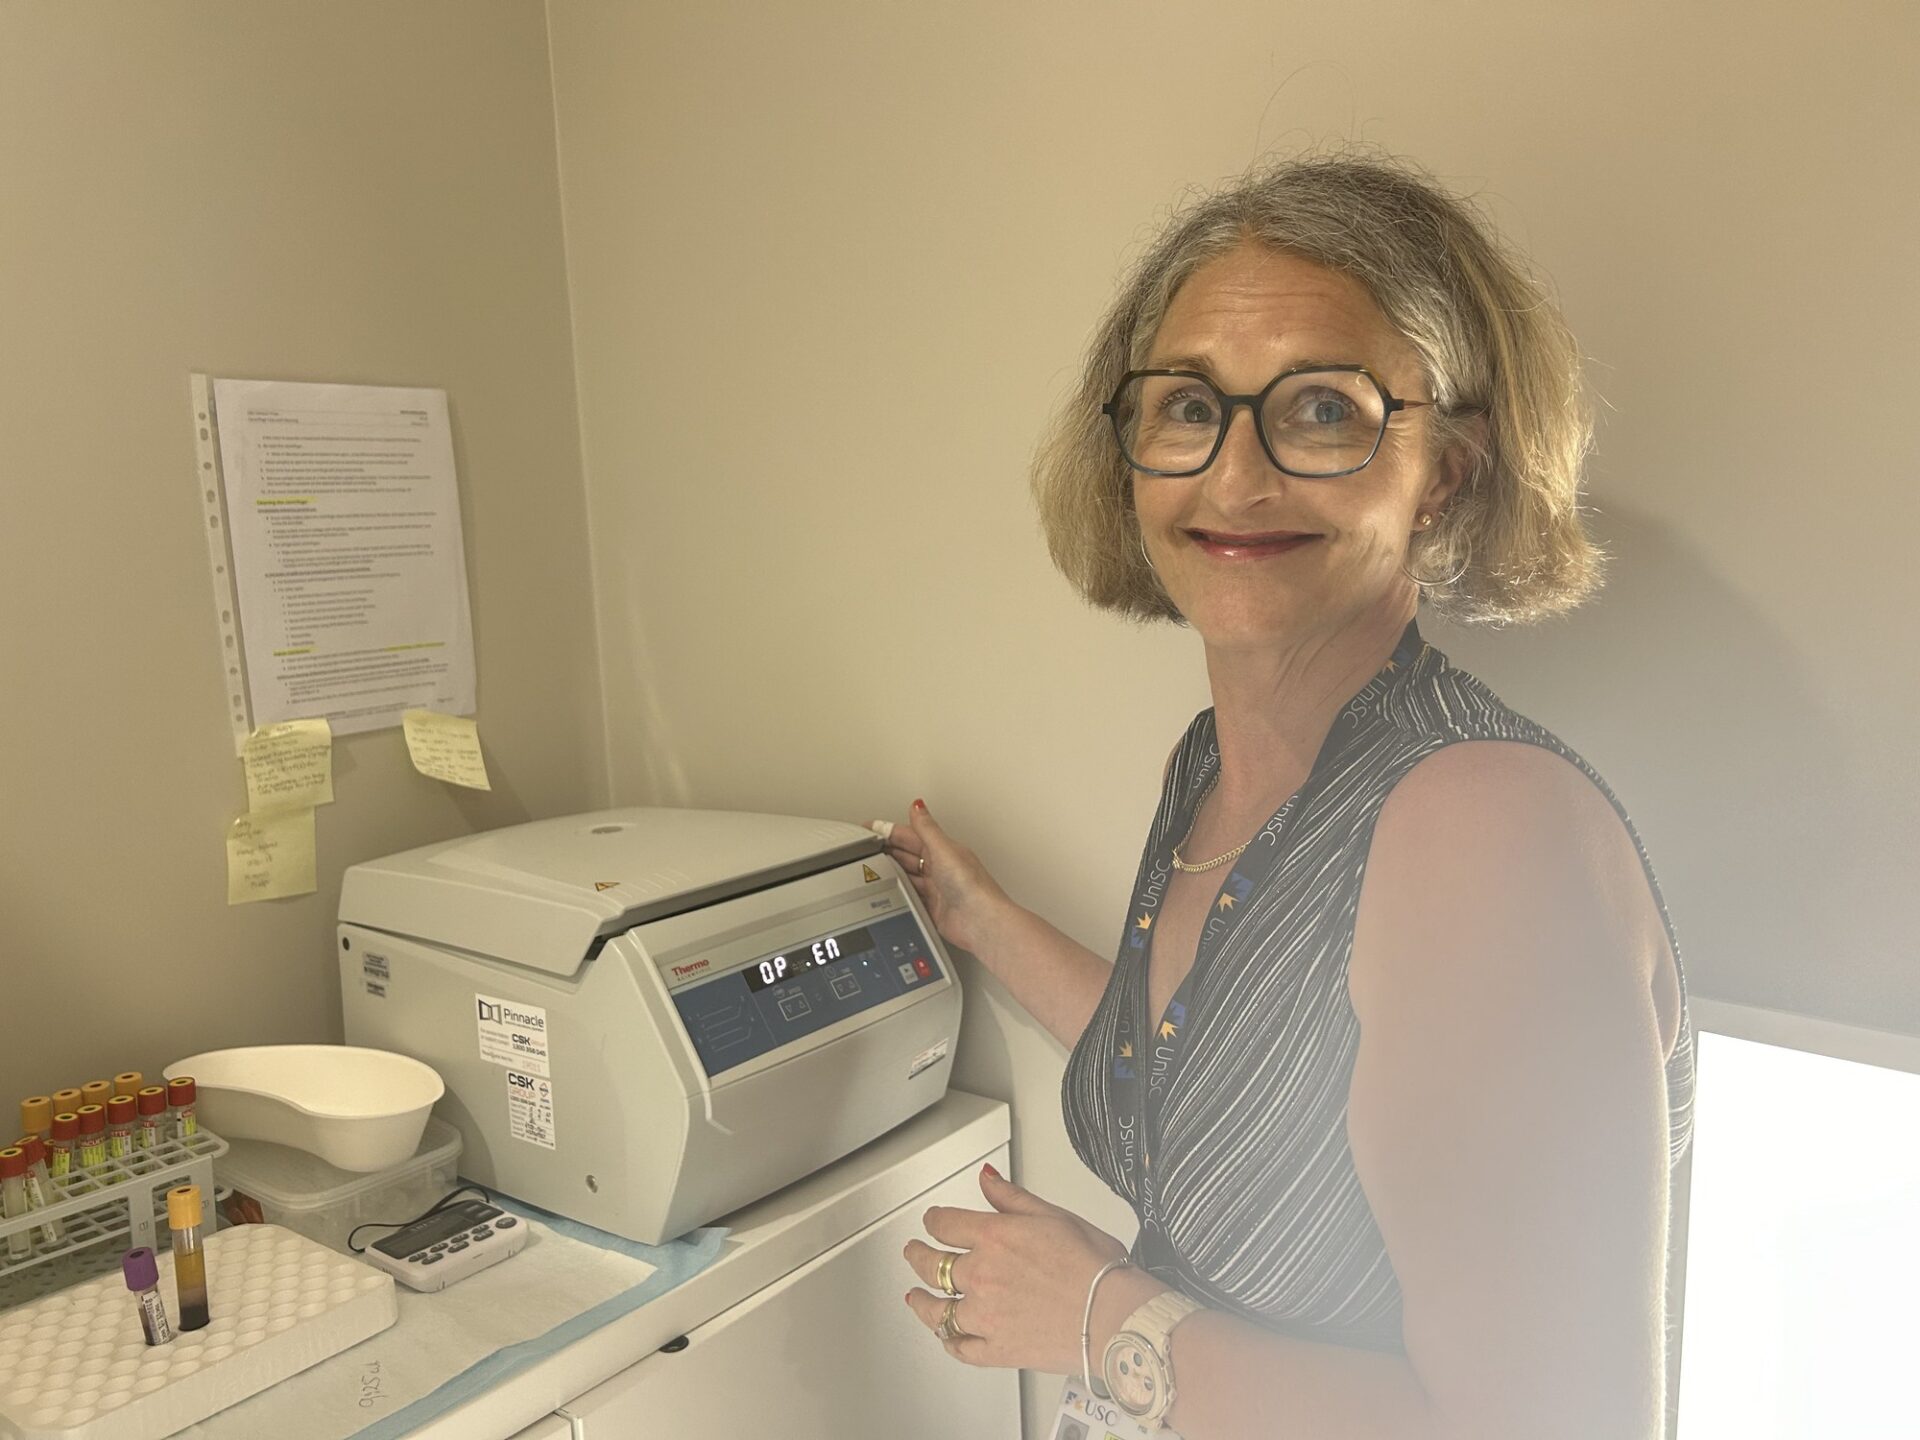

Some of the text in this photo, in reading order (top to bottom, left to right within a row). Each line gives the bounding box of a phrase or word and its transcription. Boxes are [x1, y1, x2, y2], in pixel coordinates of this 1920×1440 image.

[1342, 677, 1389, 730] UniSC
[1258, 794, 1299, 847] UniSC
[1140, 858, 1172, 908] UniSC
[672, 959, 710, 977] Thermo
[503, 1008, 544, 1028] Pinnacle
[512, 1033, 531, 1046] CSK
[508, 1072, 535, 1091] CSK
[1150, 1045, 1175, 1100] UniSC
[1119, 1114, 1135, 1173] UniSC
[1083, 1399, 1119, 1427] USC
